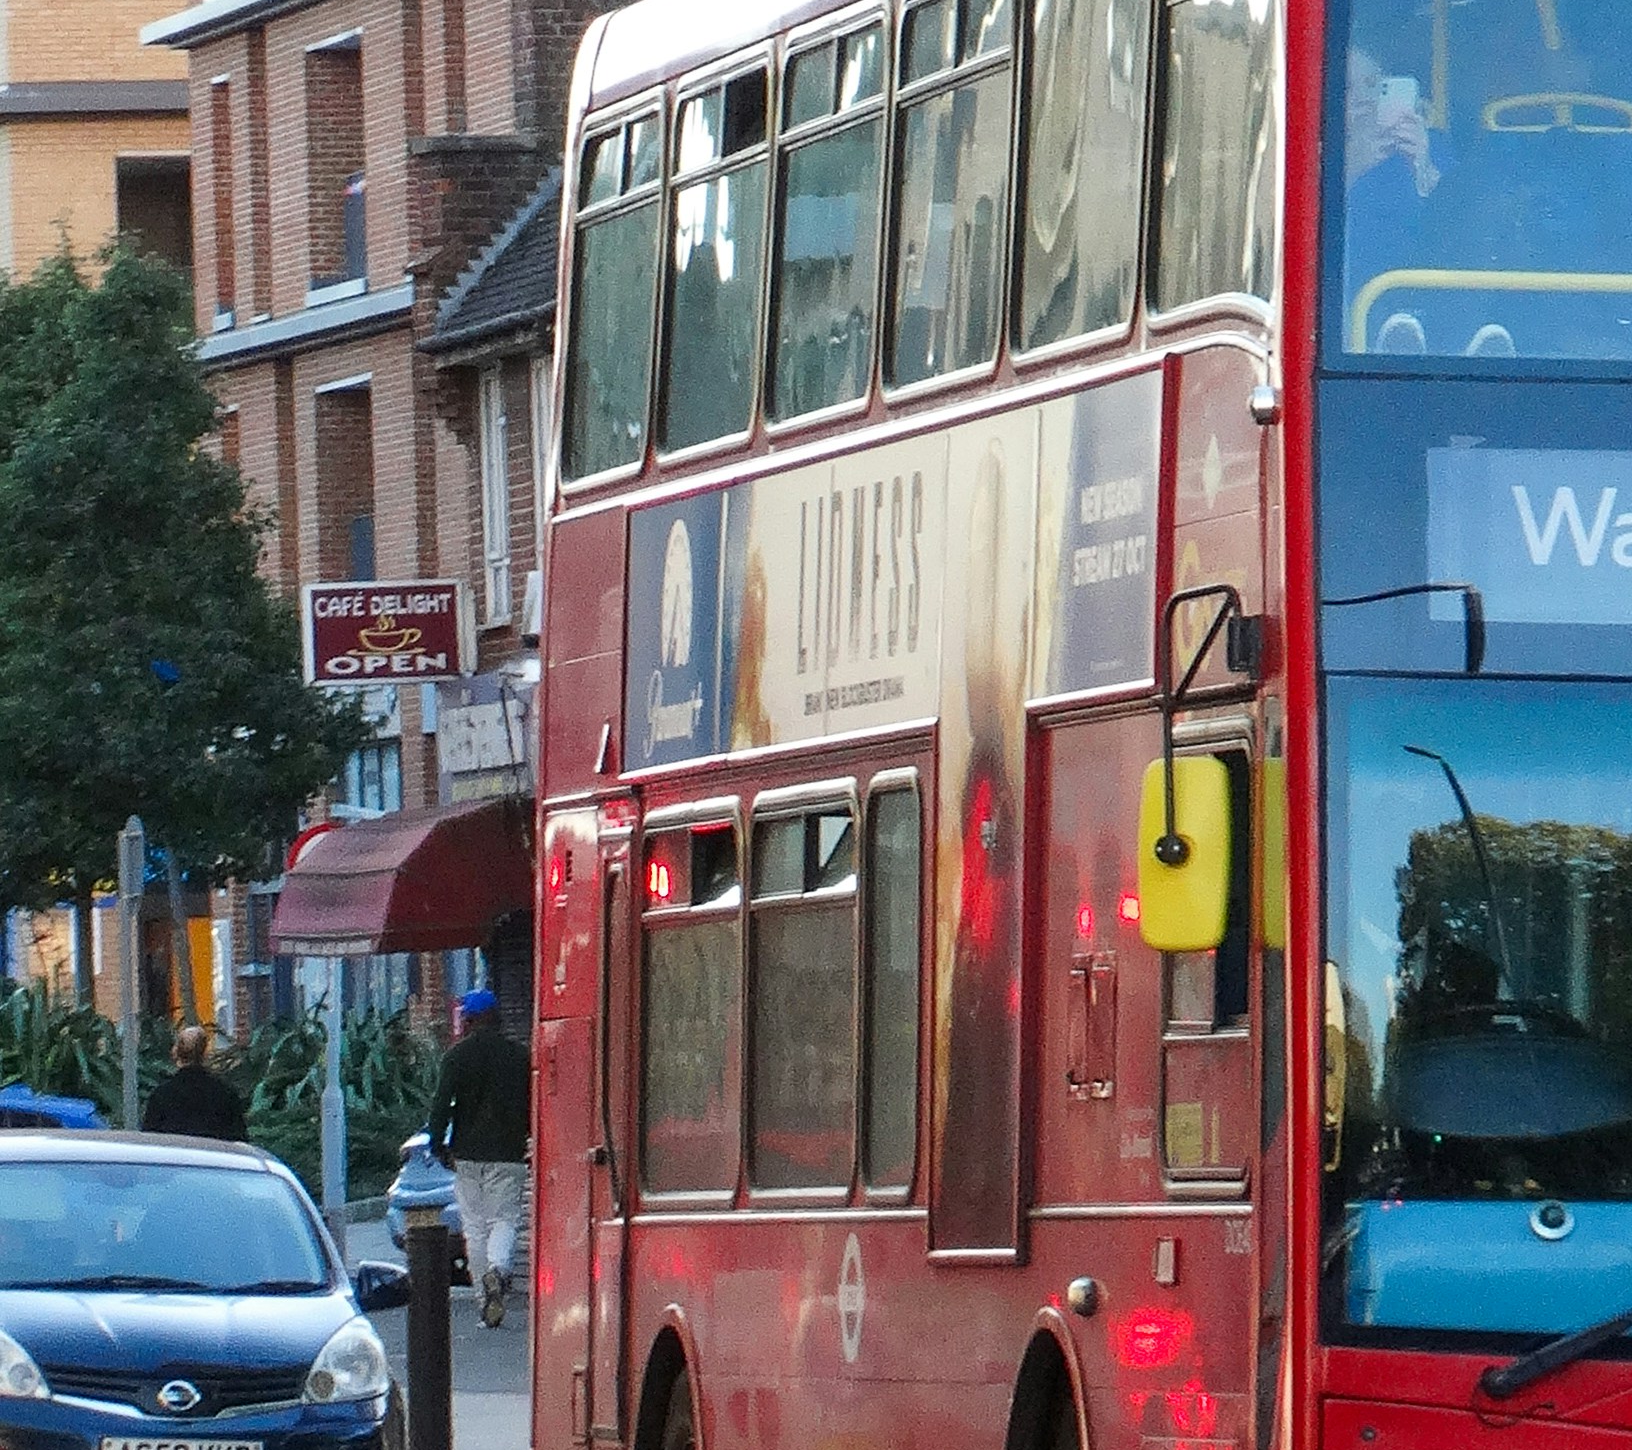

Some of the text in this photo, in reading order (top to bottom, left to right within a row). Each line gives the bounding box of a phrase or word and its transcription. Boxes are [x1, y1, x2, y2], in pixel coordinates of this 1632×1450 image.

[314, 592, 451, 619] CAFÉ DELIGHT
[325, 652, 448, 675] OPEN
